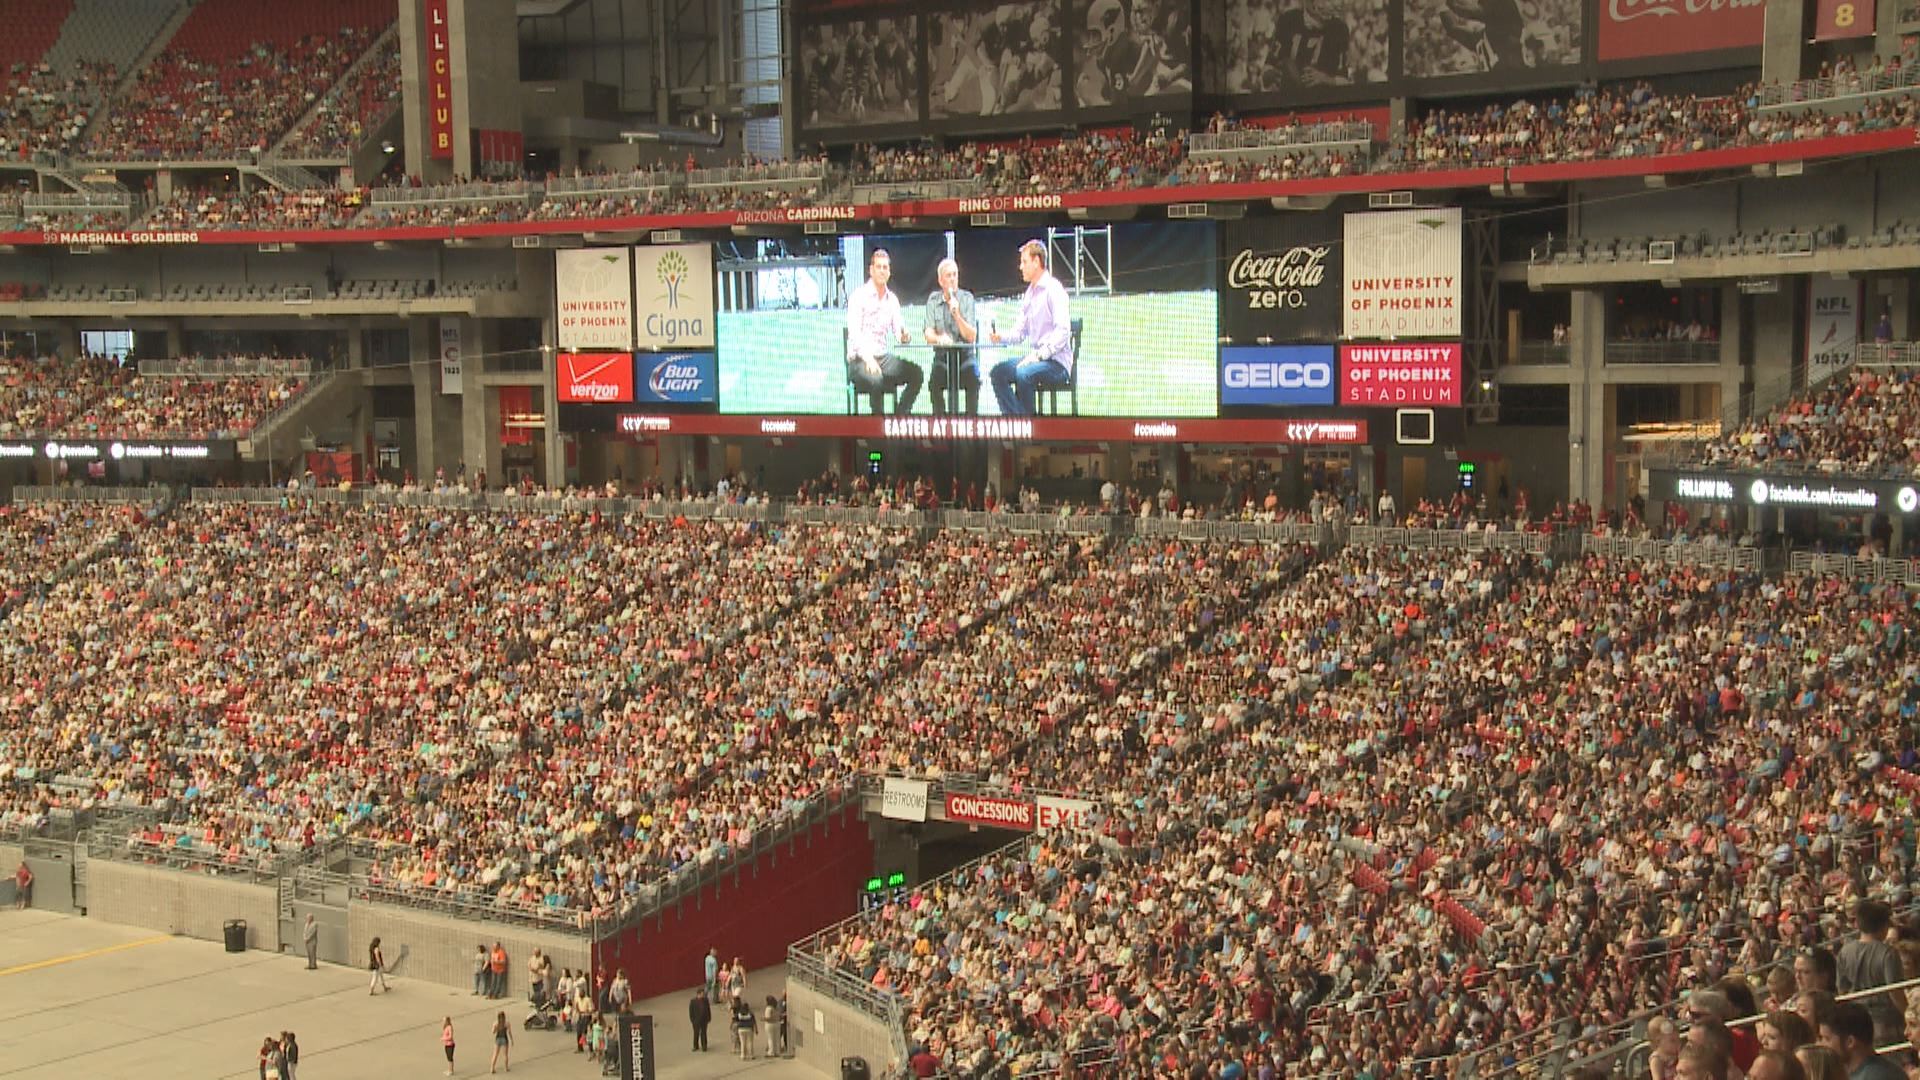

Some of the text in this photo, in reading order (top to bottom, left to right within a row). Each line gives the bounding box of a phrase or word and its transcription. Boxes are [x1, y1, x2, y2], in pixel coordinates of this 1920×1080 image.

[1835, 5, 1855, 27] 8
[435, 58, 448, 148] CLUB
[736, 195, 1062, 224] ARIZONA CARDINALS RING OF HONOR
[43, 232, 199, 244] 99 MARSHALL GOLDBERG
[1228, 247, 1331, 289] Coca-Cola
[1351, 277, 1453, 291] UNIVERSITY
[563, 301, 627, 312] UNIVERSITY
[1351, 297, 1453, 310] OF PHOENIX
[1816, 296, 1851, 310] NFL
[563, 317, 628, 327] OF PHOENIX
[646, 313, 703, 344] Cigna
[1351, 317, 1453, 331] STADIUM
[564, 332, 628, 343] STADIUM
[1351, 349, 1451, 362] UNIVERSITY
[1224, 362, 1331, 388] GEICO
[1350, 368, 1451, 381] OF PHOENIX
[571, 381, 619, 400] verizon
[657, 379, 703, 391] LIGHT
[1351, 387, 1451, 401] STADIUM
[884, 419, 1032, 438] EASTER AT THE STADIUM
[1678, 479, 1716, 497] FOLLOW
[884, 790, 926, 809] RESTROOMS
[951, 796, 1030, 823] CONCESSIONS
[1039, 806, 1090, 829] EXI
[889, 872, 904, 886] ATM
